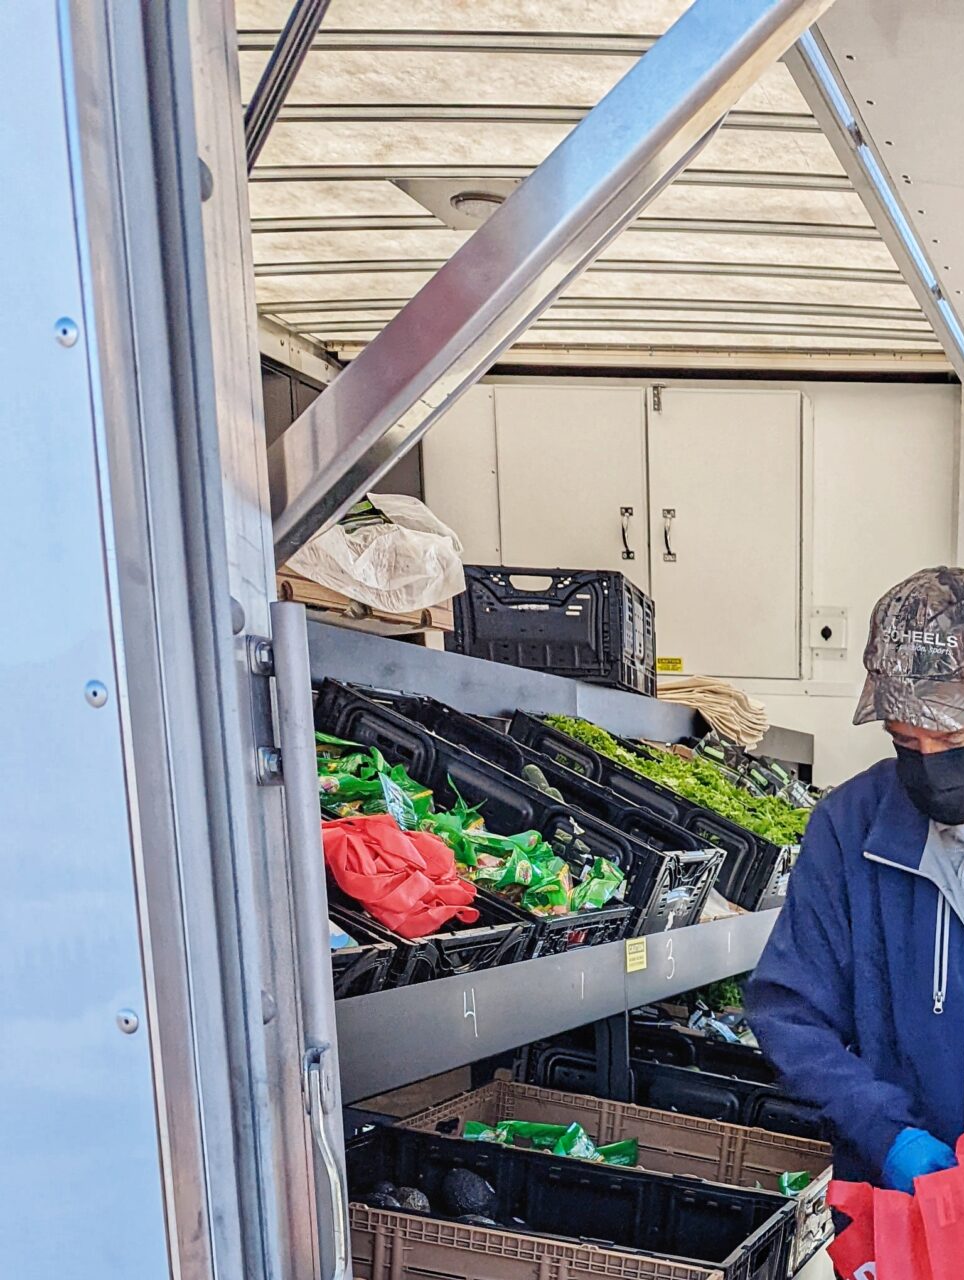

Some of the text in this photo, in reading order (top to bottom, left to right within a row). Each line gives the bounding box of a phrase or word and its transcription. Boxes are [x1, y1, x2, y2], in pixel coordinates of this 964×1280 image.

[882, 629, 958, 648] SCHEELS
[463, 988, 478, 1038] 4
[666, 938, 676, 980] 3
